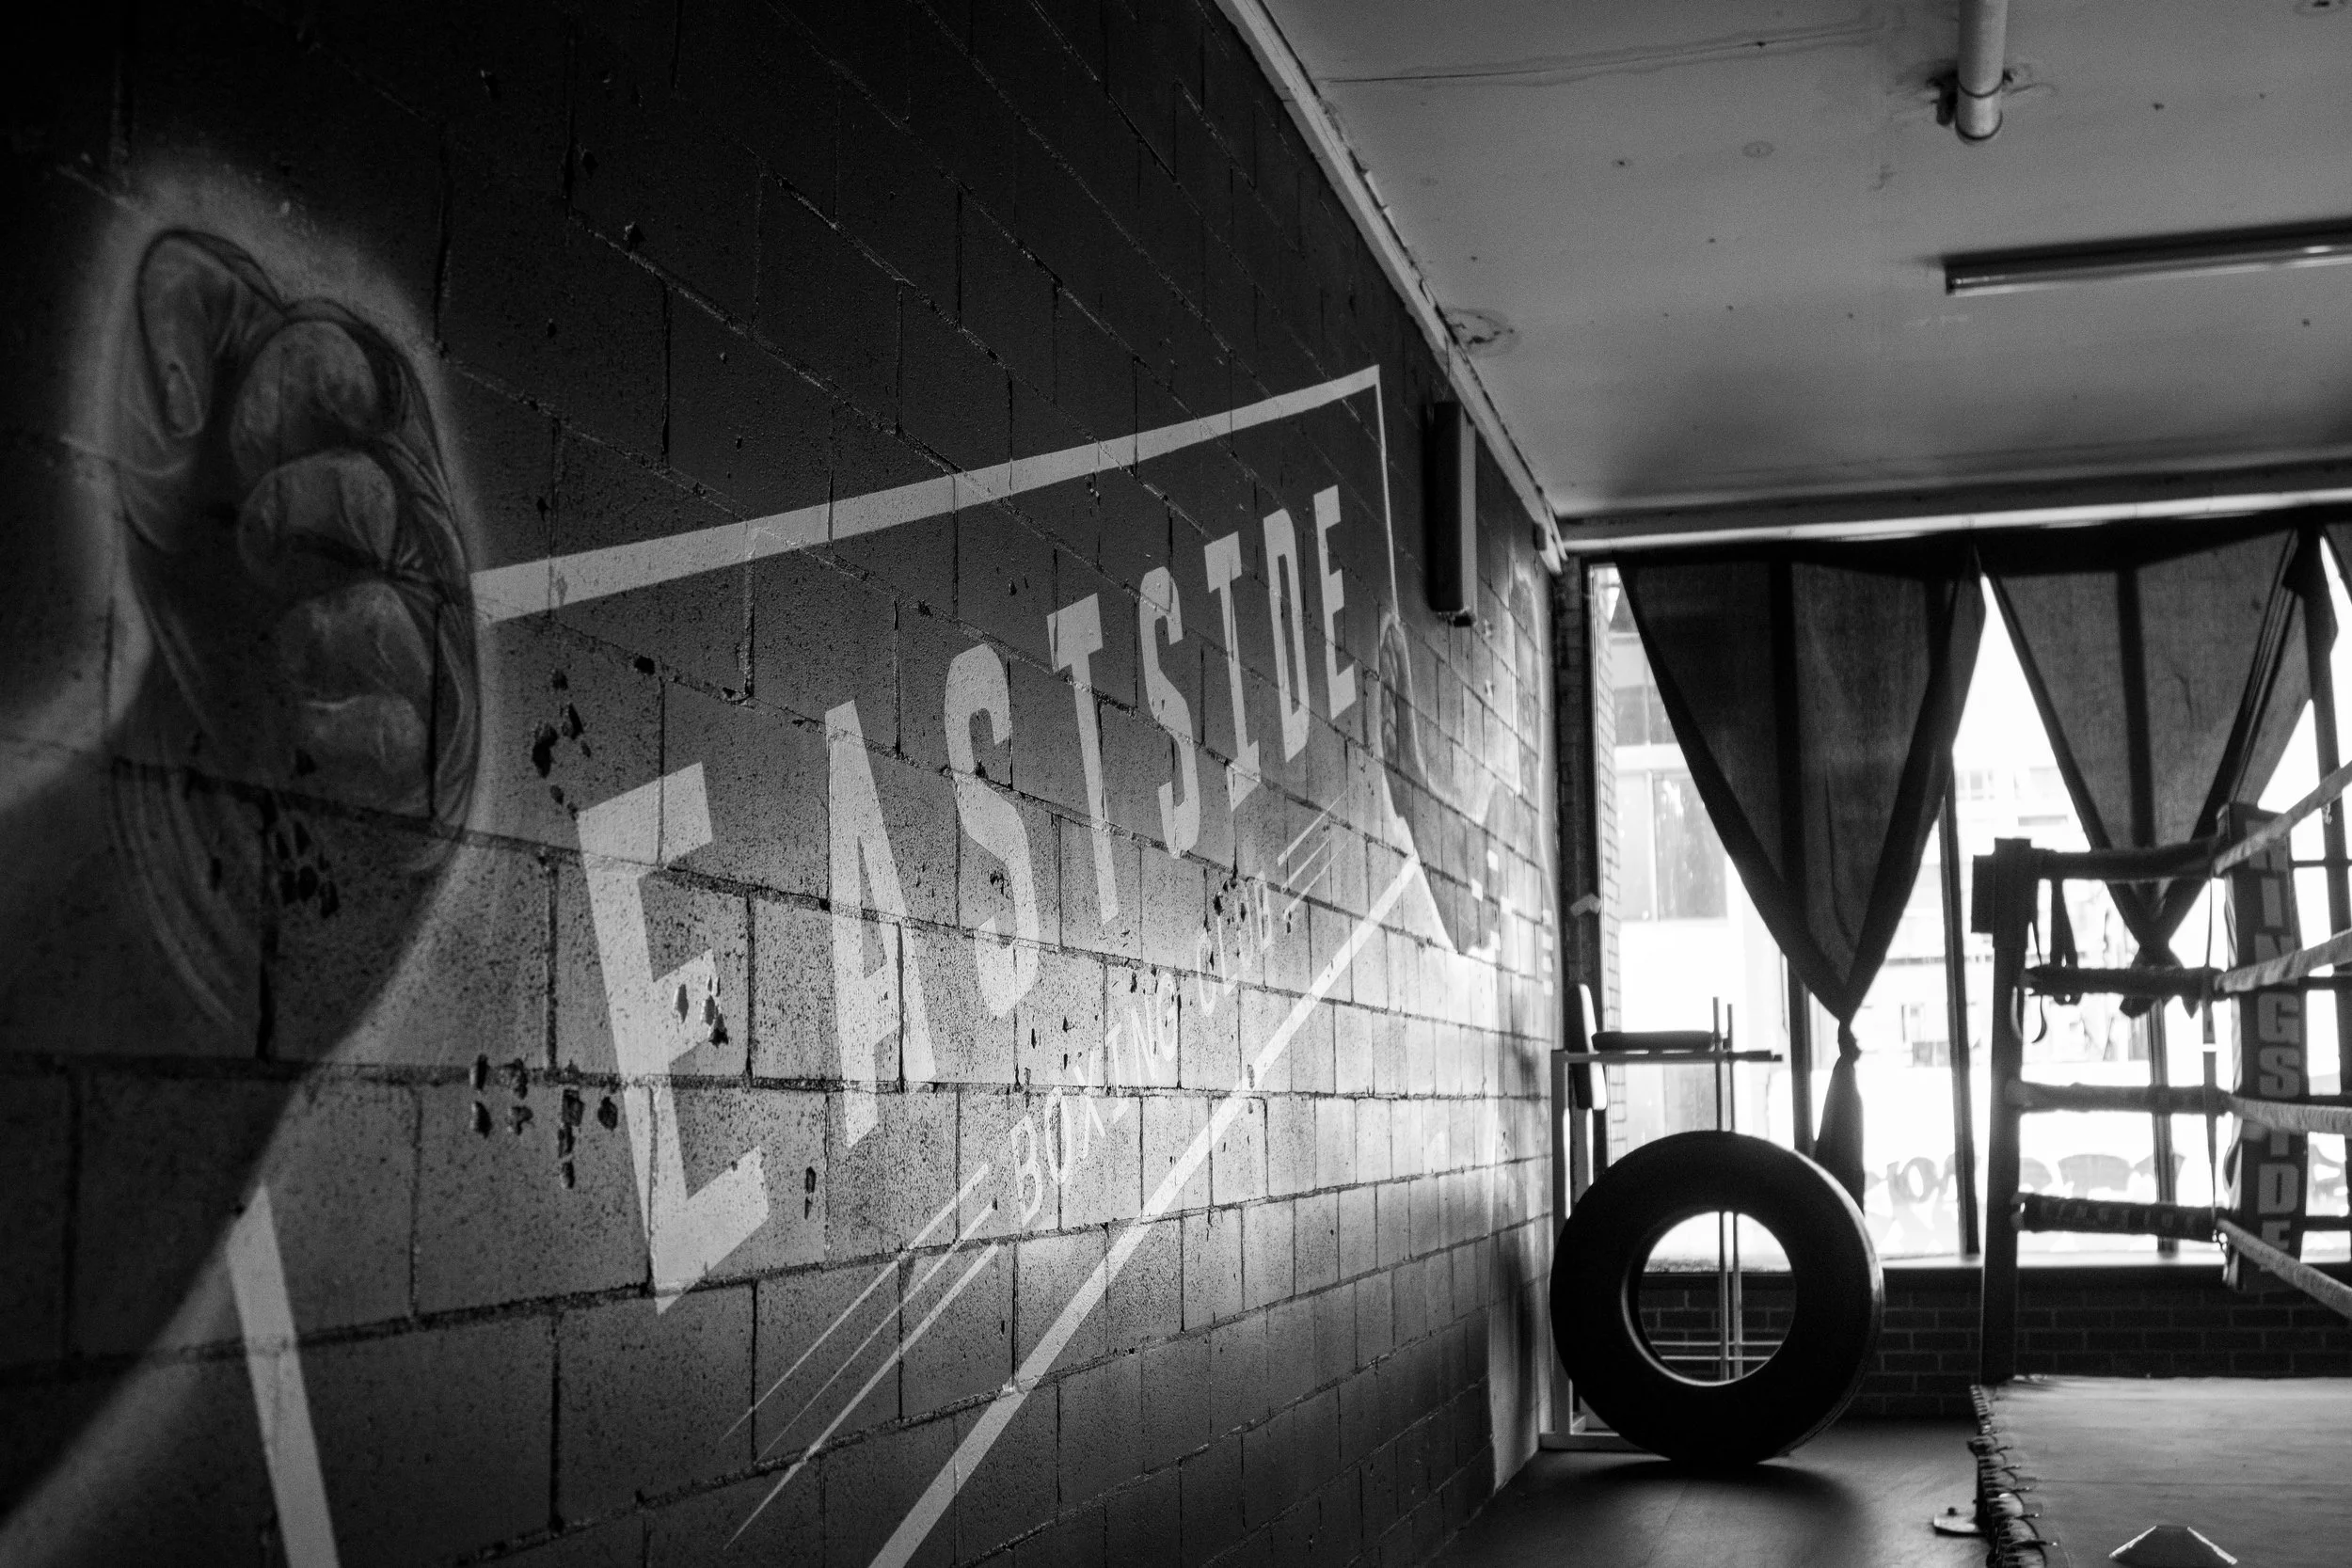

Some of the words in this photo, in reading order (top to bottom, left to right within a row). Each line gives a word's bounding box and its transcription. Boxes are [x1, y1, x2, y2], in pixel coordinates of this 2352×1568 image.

[579, 485, 1356, 1315] EASTSIDE
[1010, 973, 1179, 1227] BOXING
[1197, 871, 1272, 1017] CLUB
